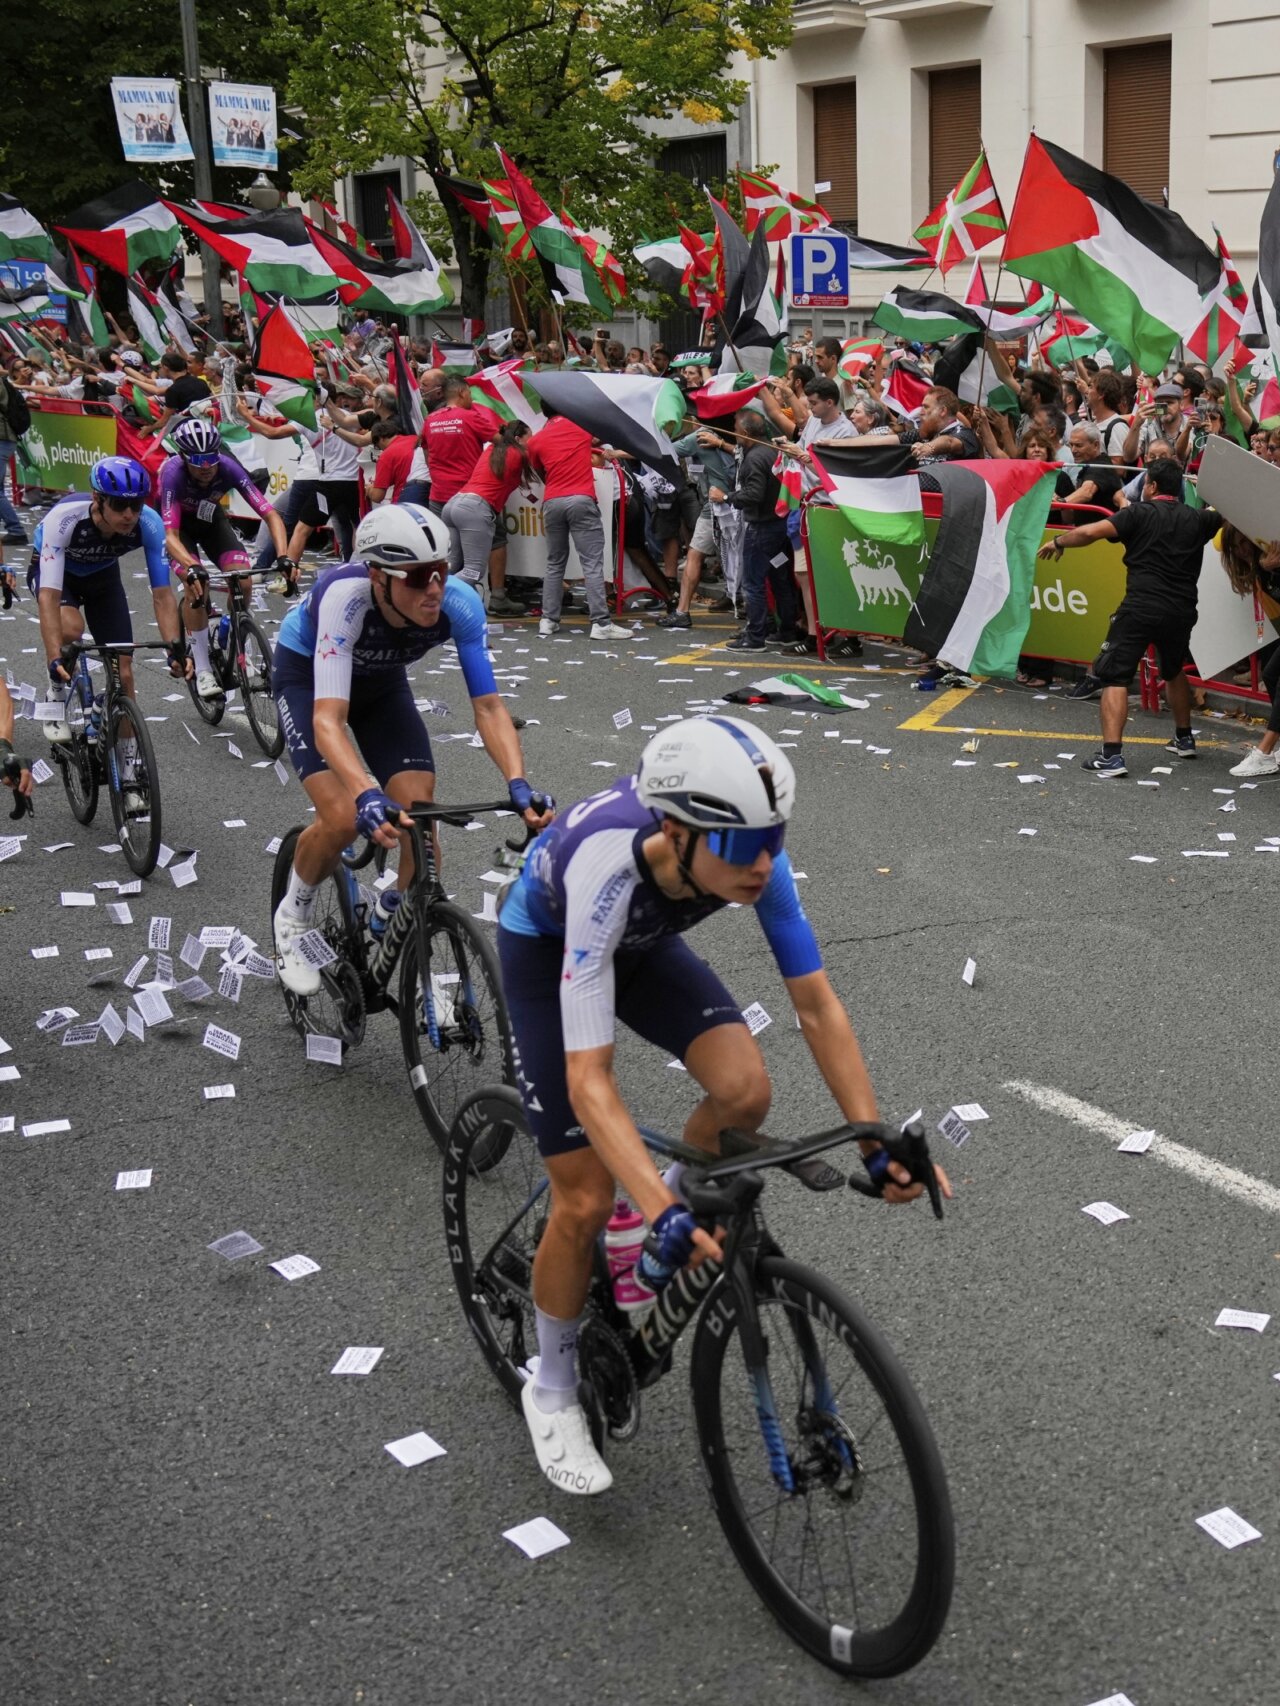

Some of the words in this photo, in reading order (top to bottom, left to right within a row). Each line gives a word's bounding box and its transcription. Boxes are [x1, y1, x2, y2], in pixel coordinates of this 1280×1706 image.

[118, 90, 153, 104] MAMMA
[154, 91, 175, 104] MIA!
[215, 94, 249, 109] MAMMA
[251, 97, 271, 112] MIA!
[803, 238, 837, 293] P
[277, 695, 296, 736] ISRAEL
[459, 1100, 488, 1137] INC
[445, 1139, 464, 1264] BLACK
[546, 1465, 595, 1493] nimbl
